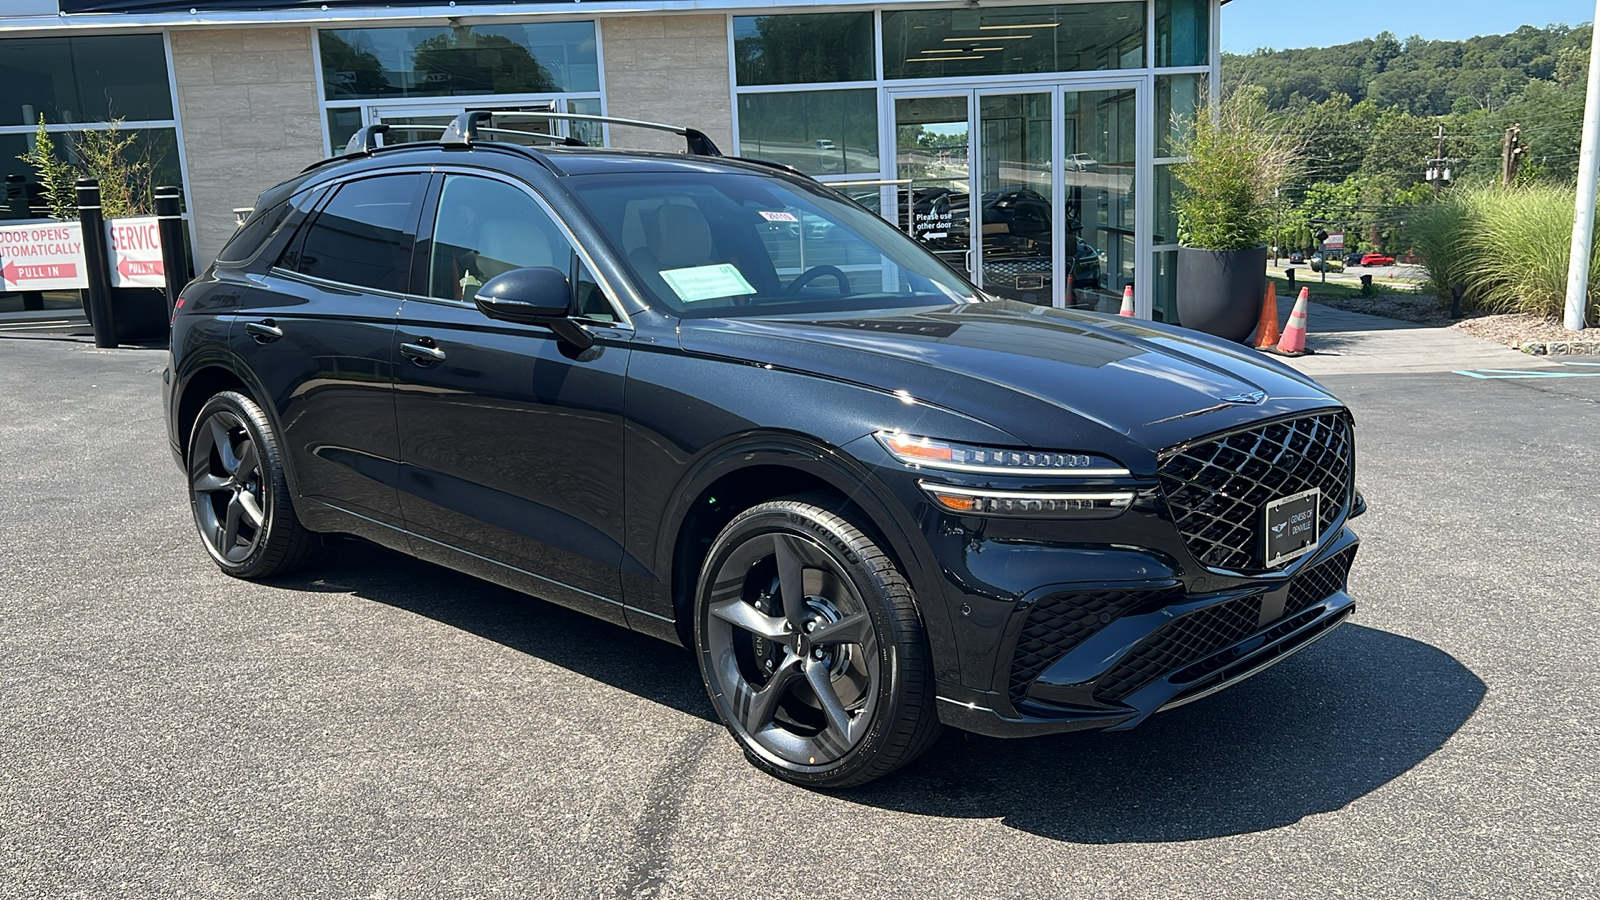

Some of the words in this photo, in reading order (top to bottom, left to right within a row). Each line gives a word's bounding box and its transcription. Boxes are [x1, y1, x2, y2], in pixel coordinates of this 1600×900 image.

[916, 213, 938, 221] Please
[31, 228, 70, 241] OPENS
[110, 224, 161, 251] SERVIC
[18, 267, 45, 278] PULL
[47, 266, 59, 276] IN
[128, 262, 146, 273] PULL
[804, 519, 858, 563] MICHELIN
